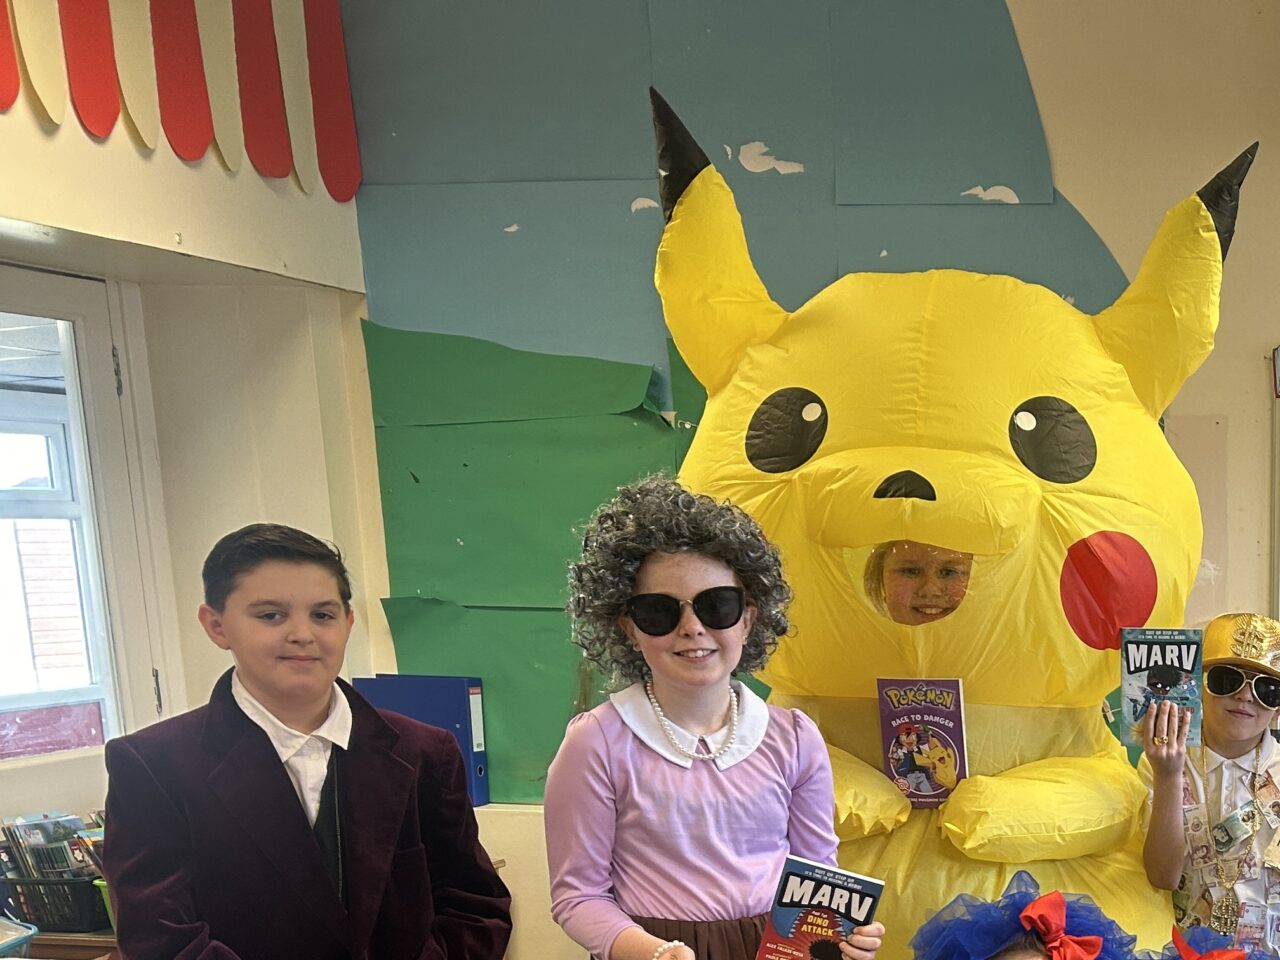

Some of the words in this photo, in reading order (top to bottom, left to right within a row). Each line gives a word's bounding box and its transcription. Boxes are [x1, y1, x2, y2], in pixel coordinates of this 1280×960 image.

[1127, 643, 1197, 672] MARV
[891, 715, 909, 728] RACE
[911, 714, 922, 722] TO
[924, 714, 954, 729] DANGER
[782, 875, 873, 922] MARV
[807, 914, 830, 928] DINO
[801, 924, 834, 937] ATTACK
